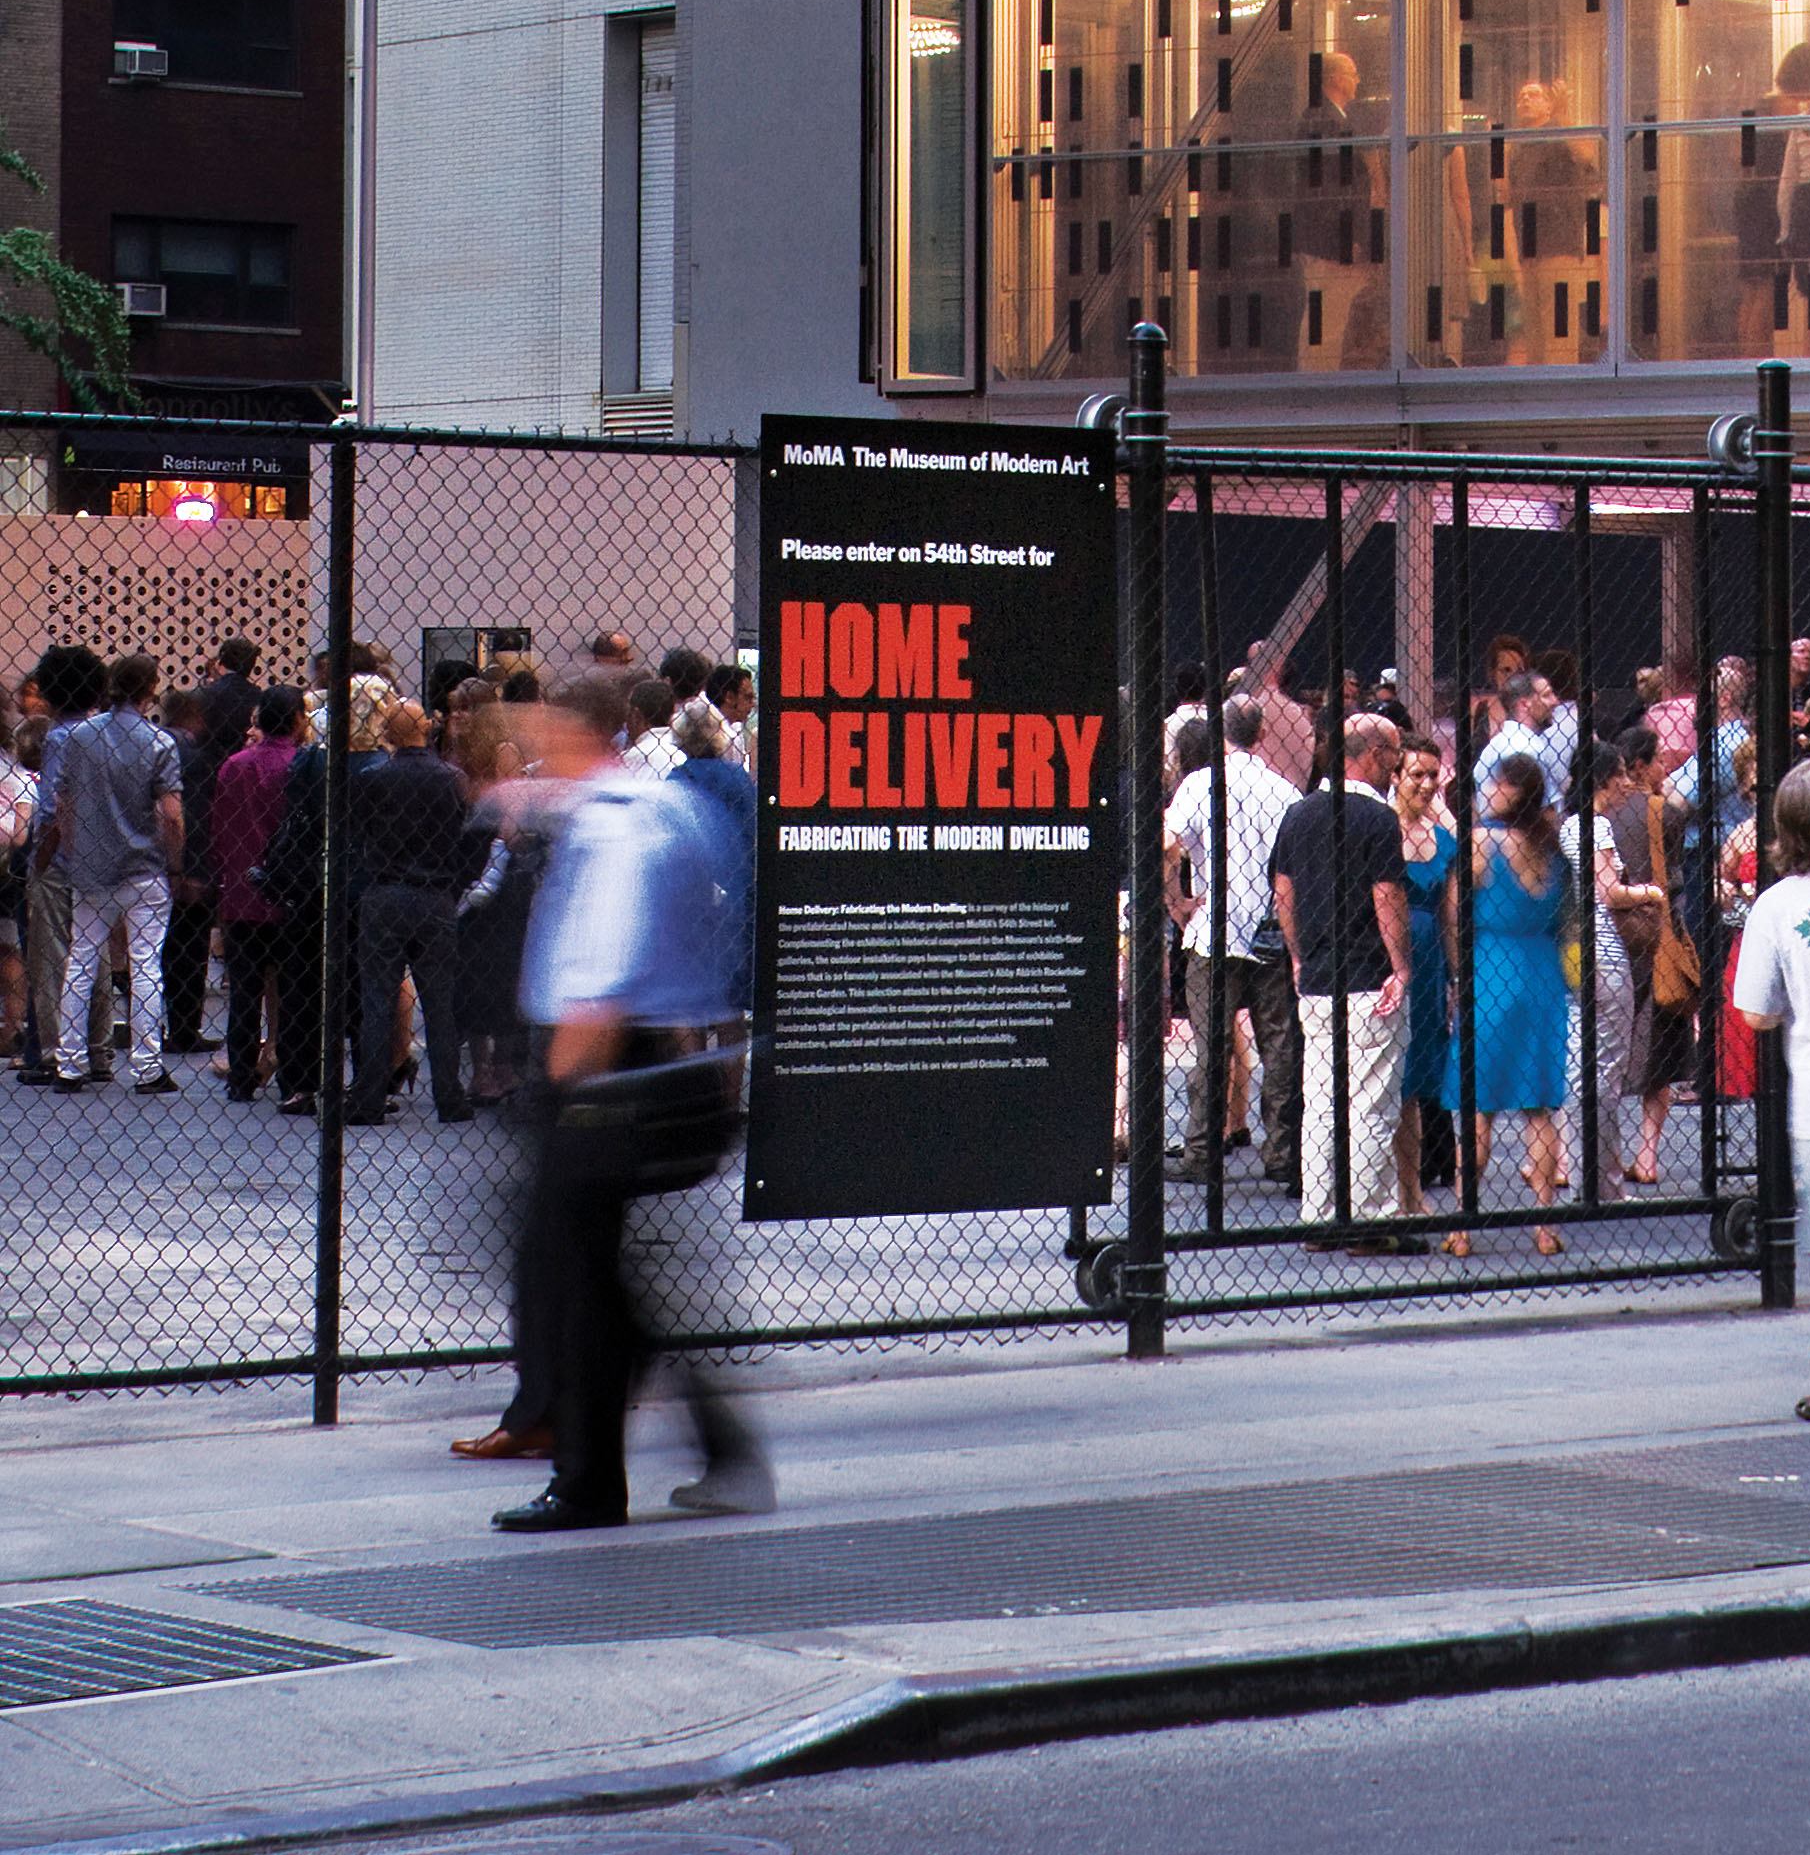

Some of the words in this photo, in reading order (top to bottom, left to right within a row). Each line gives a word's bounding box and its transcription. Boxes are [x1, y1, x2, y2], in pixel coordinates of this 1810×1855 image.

[162, 454, 246, 473] Restaurant
[253, 458, 282, 473] Pub
[783, 444, 844, 467] MoMA
[852, 446, 887, 469] The
[890, 448, 967, 471] Museum
[970, 451, 989, 472] of
[991, 452, 1057, 474] Modern
[1060, 455, 1089, 476] Art
[781, 539, 843, 562] Please
[846, 543, 895, 564] enter
[898, 548, 921, 564] on
[924, 542, 967, 565] 54th
[970, 544, 1026, 566] Street
[1028, 545, 1055, 567] for
[780, 601, 973, 700] HOME
[779, 711, 1103, 809] DELIVERY
[779, 826, 890, 851] FABRICATING
[897, 826, 928, 850] THE
[934, 826, 1004, 850] MODERN
[1010, 826, 1090, 850] DWELLING
[887, 903, 899, 913] the
[969, 902, 975, 912] is
[1009, 902, 1017, 912] of
[1019, 902, 1031, 912] the
[1061, 901, 1069, 911] of
